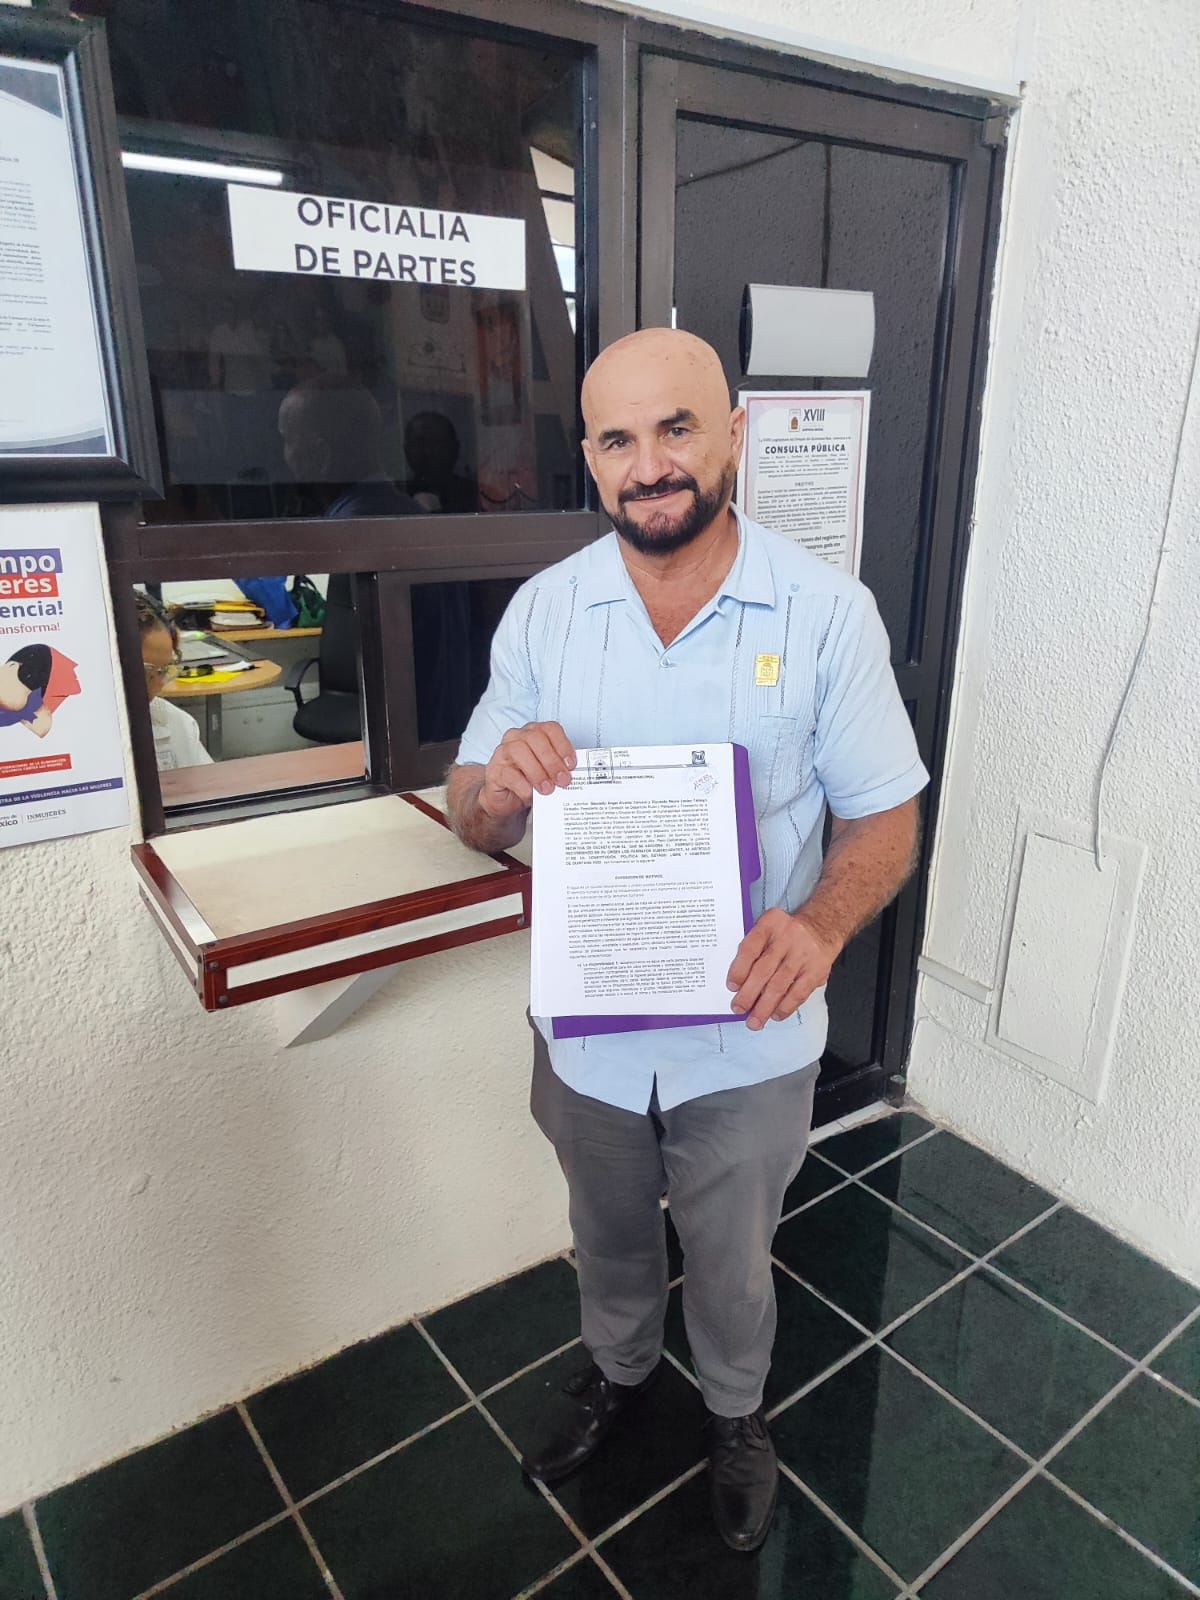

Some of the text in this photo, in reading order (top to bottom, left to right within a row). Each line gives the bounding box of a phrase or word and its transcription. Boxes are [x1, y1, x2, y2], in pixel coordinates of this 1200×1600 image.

[297, 197, 470, 243] OFICIALIA
[294, 243, 476, 286] DE PARTES
[765, 442, 846, 455] CONSULTA PÚBLICA
[0, 577, 53, 595] eres
[0, 600, 63, 619] encia!
[27, 809, 67, 820] INMUJERES
